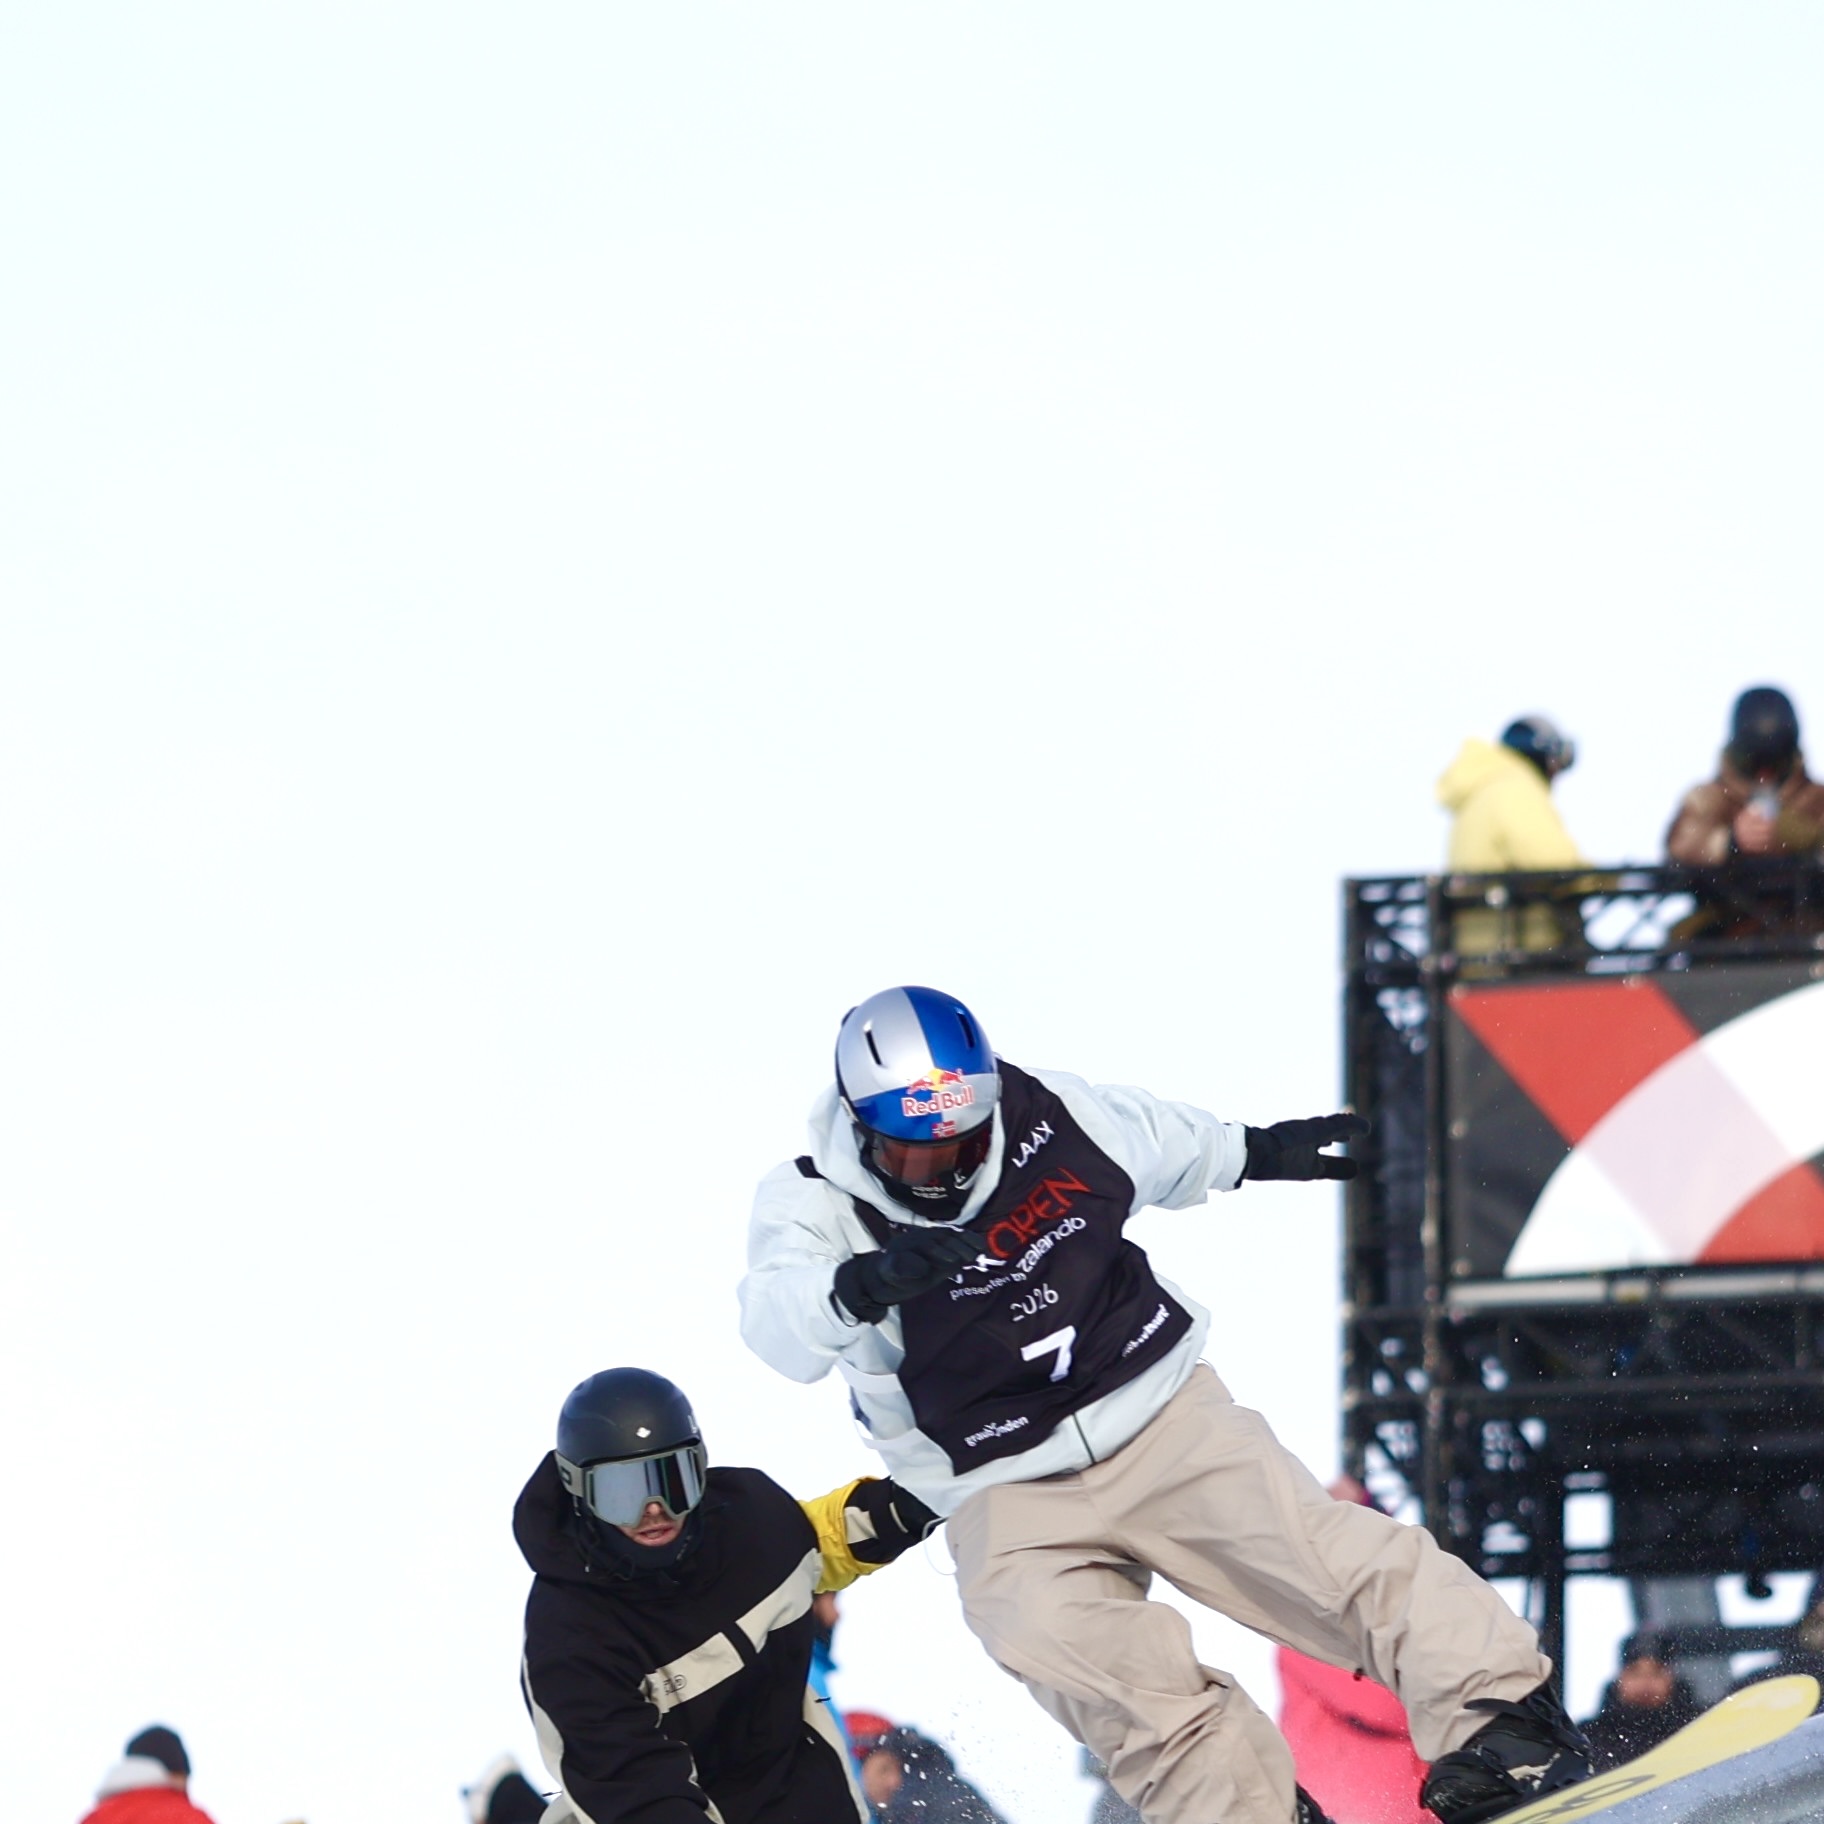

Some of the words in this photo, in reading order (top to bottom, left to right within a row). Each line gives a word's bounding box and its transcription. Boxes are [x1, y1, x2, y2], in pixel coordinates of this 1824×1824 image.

[901, 1092, 940, 1117] Red
[941, 1084, 975, 1112] Bull
[1012, 1120, 1055, 1169] LAAX
[986, 1167, 1094, 1260] OPEN
[1015, 1216, 1087, 1273] zalando
[1009, 1282, 1060, 1322] 2026
[1020, 1324, 1077, 1383] 7
